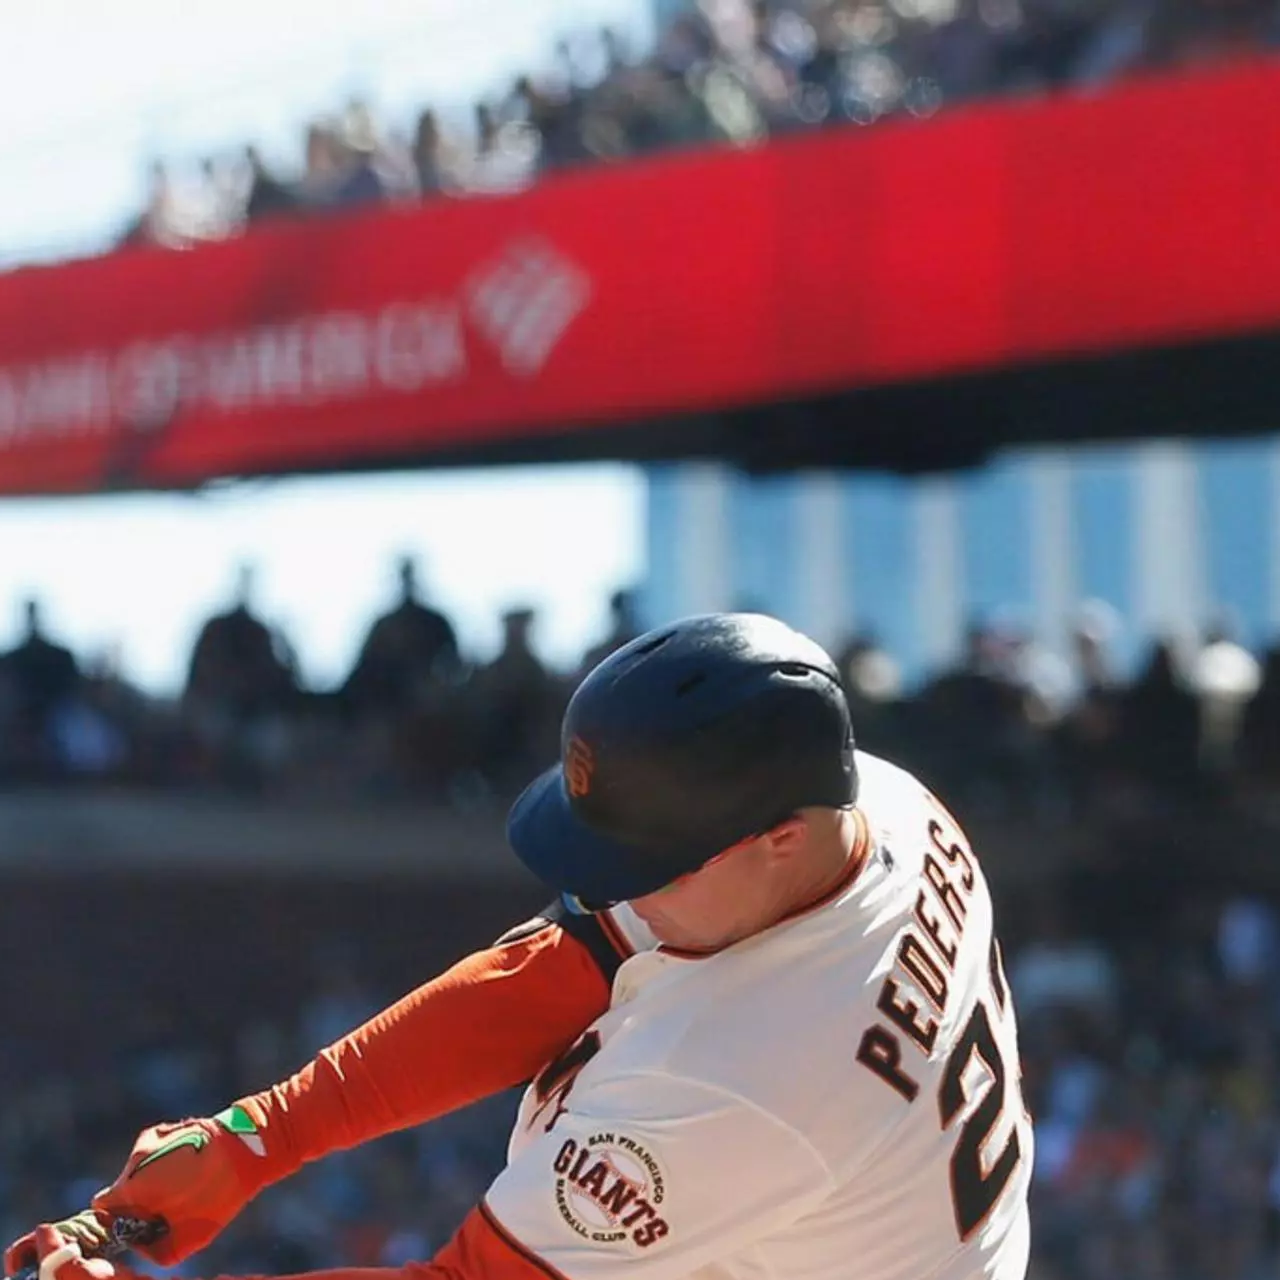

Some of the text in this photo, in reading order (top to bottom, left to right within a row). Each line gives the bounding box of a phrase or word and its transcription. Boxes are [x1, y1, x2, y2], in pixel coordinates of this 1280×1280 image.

[855, 812, 974, 1103] PEDERS
[937, 950, 1021, 1243] 2
[553, 1138, 669, 1248] GIANTS
[555, 1178, 627, 1242] BASEBALL CLUB
[589, 1133, 665, 1204] SAN FRANCISCO
